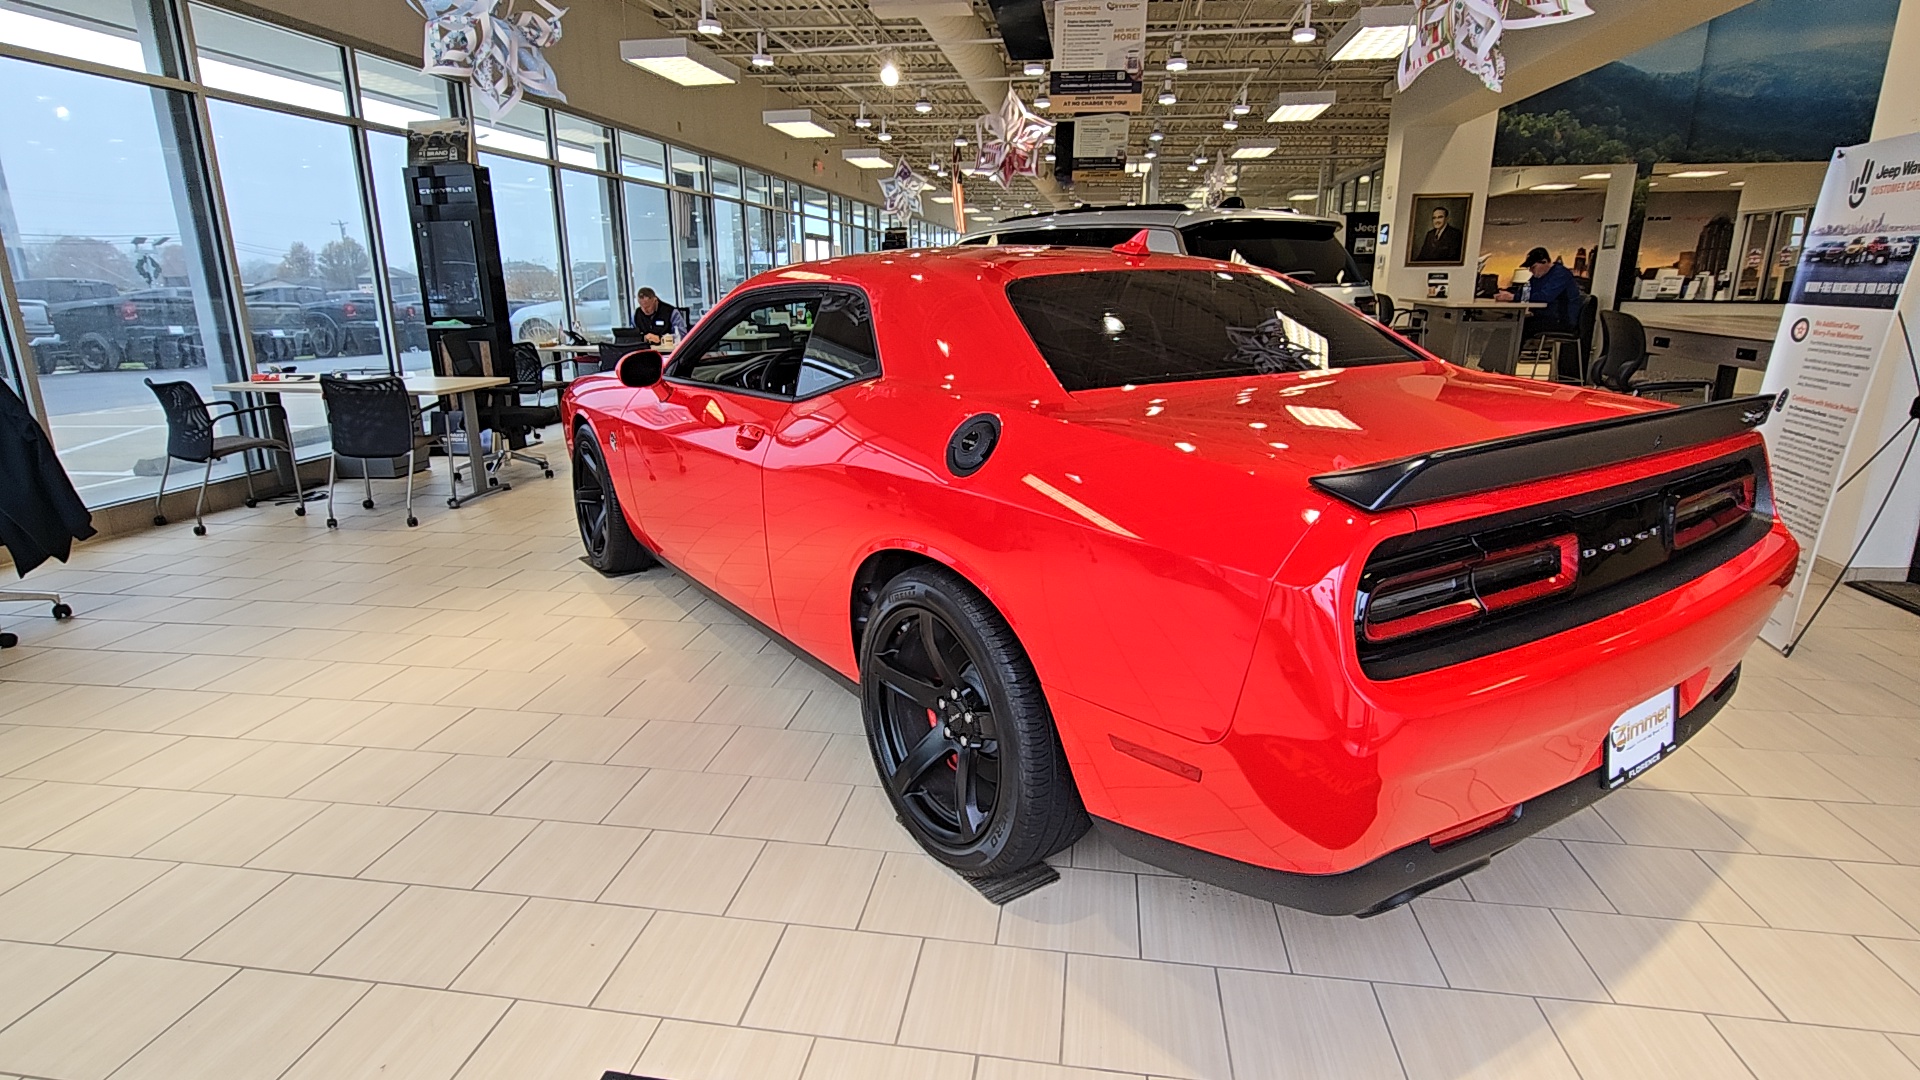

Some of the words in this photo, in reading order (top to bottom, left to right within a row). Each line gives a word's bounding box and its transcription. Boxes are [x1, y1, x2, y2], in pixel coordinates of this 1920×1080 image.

[1113, 33, 1140, 41] MORE!
[1876, 165, 1901, 180] Jeep
[1871, 182, 1905, 196] CUSTOMER
[1583, 526, 1660, 558] DODGE
[1612, 704, 1671, 750] Zimmer
[1628, 752, 1661, 779] FLORENCE
